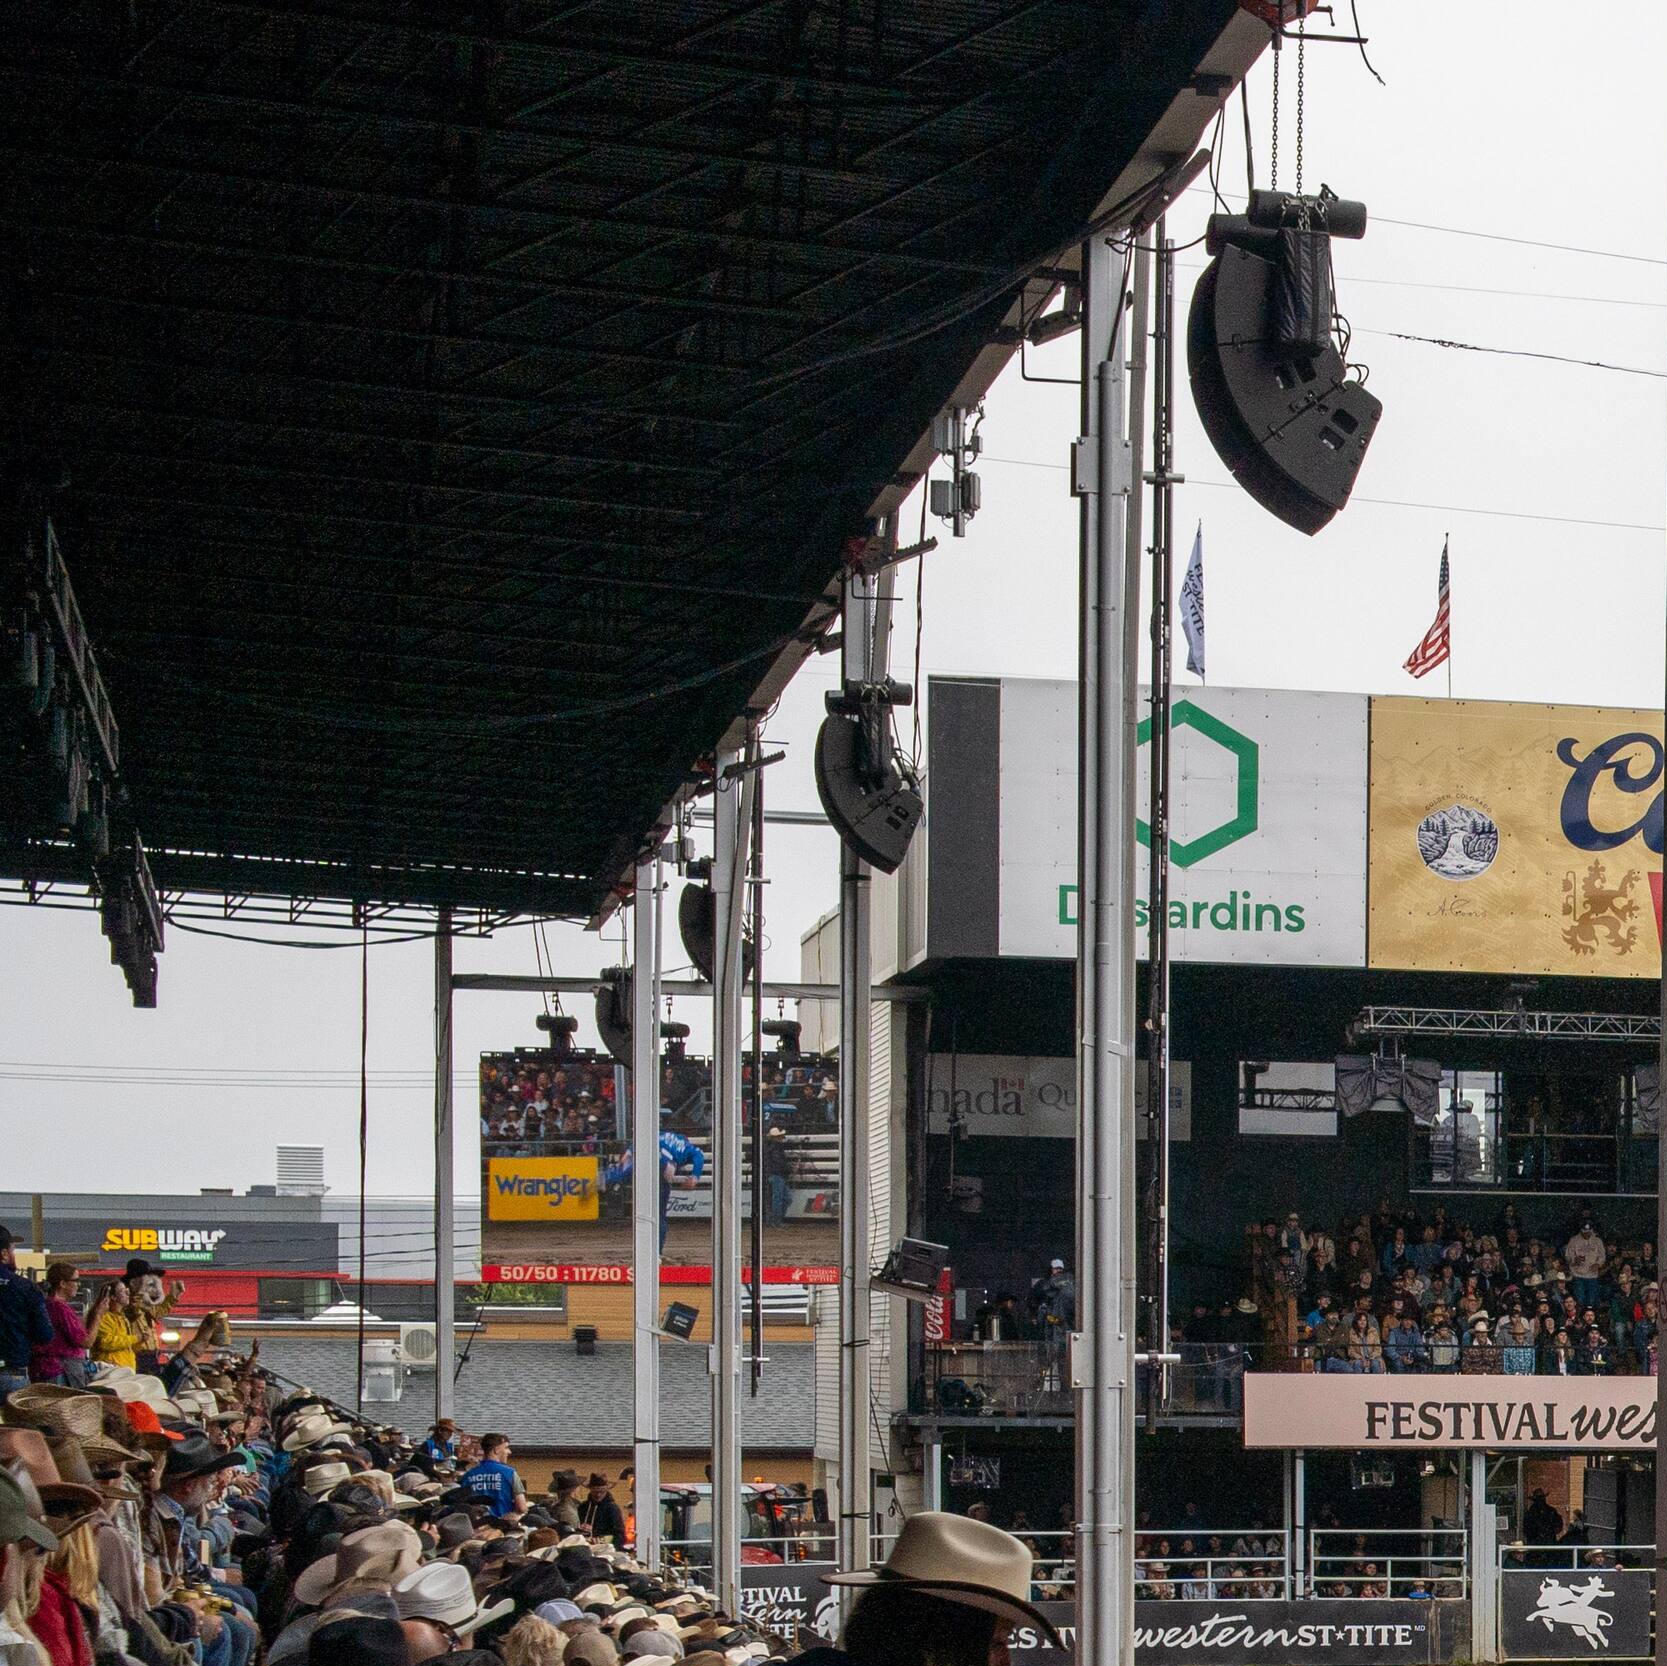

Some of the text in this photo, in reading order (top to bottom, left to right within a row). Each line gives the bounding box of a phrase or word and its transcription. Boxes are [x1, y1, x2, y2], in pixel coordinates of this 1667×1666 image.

[1455, 793, 1492, 814] COLORADO
[1059, 885, 1305, 938] Dsardins
[494, 1174, 591, 1207] Wrangler
[101, 1228, 226, 1251] SUBWAY
[161, 1251, 213, 1261] RESTAURANT
[500, 1266, 558, 1282] 50/50
[572, 1267, 621, 1282] 11780
[1365, 1401, 1568, 1440] FESTIVAL
[472, 1482, 502, 1492] OITIÉ
[740, 1586, 807, 1604] TIVAL
[1134, 1613, 1300, 1648] western
